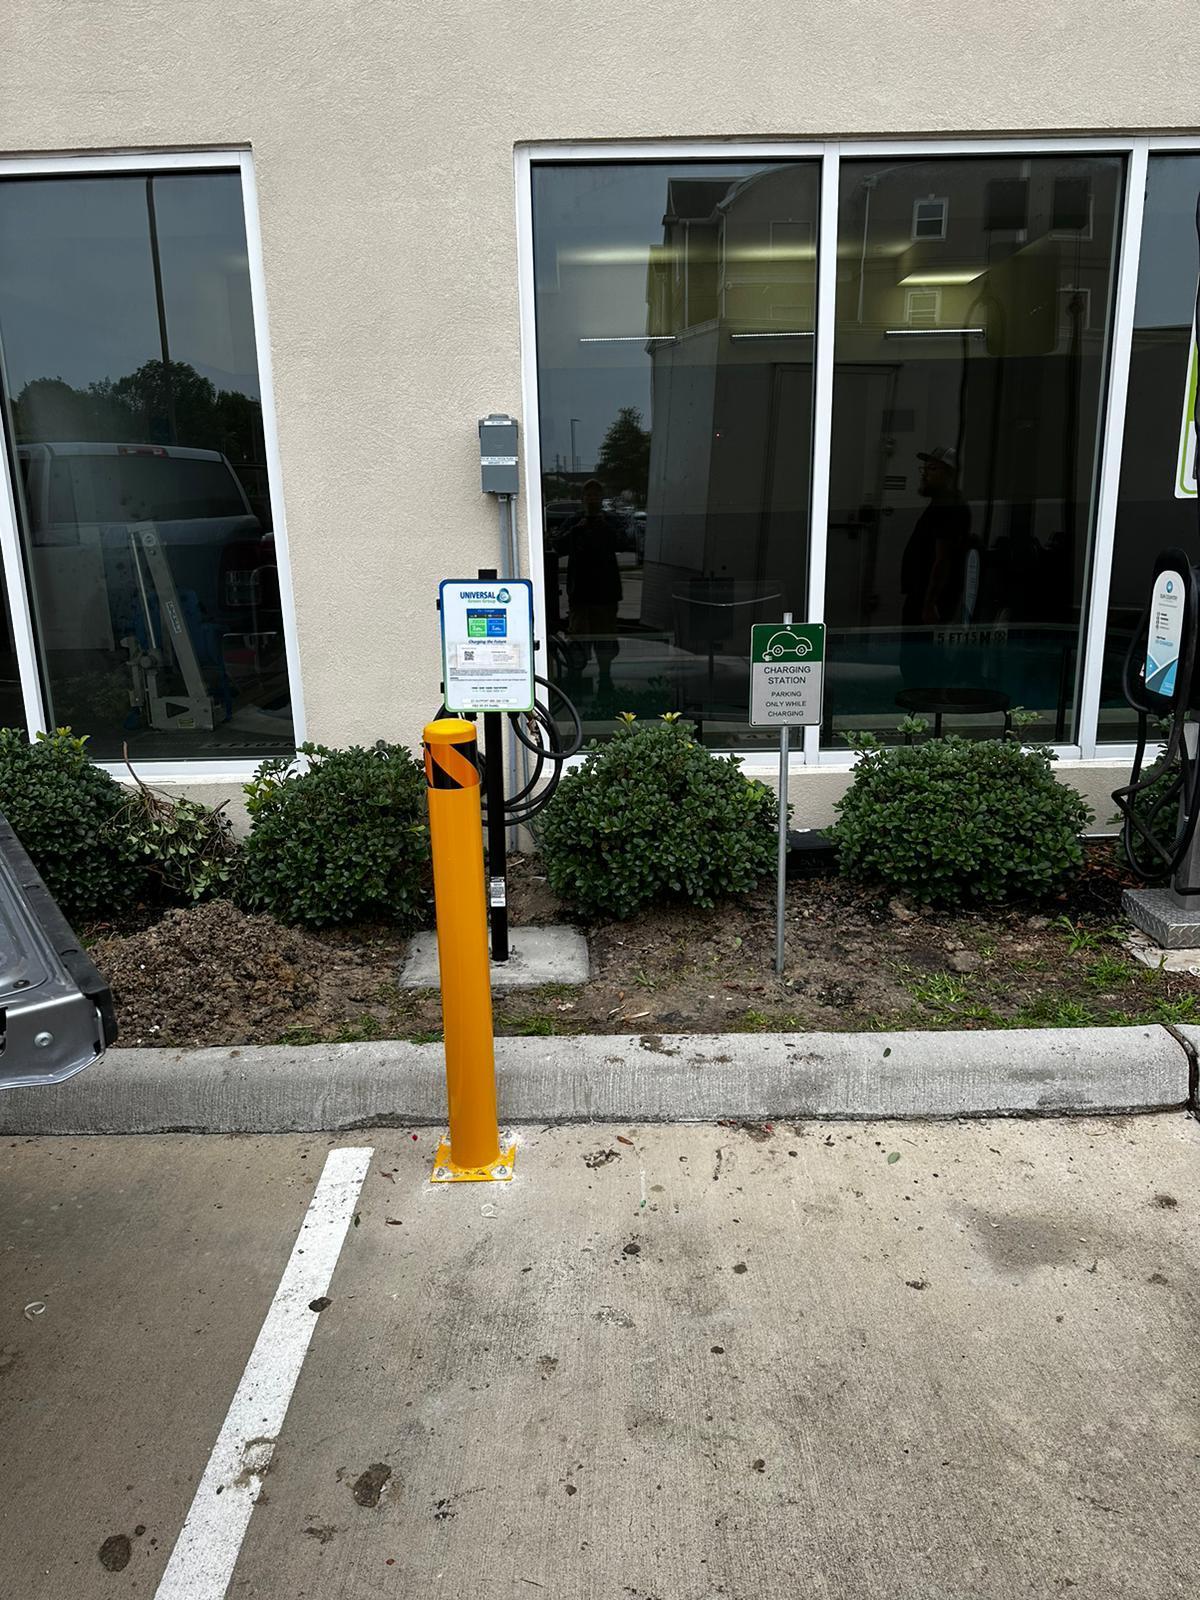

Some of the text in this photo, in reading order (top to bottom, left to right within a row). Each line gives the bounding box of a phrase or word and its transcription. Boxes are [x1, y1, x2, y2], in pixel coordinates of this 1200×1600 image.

[460, 591, 496, 599] UNIVERSAL
[764, 665, 811, 674] CHARGING
[768, 676, 806, 684] STATION
